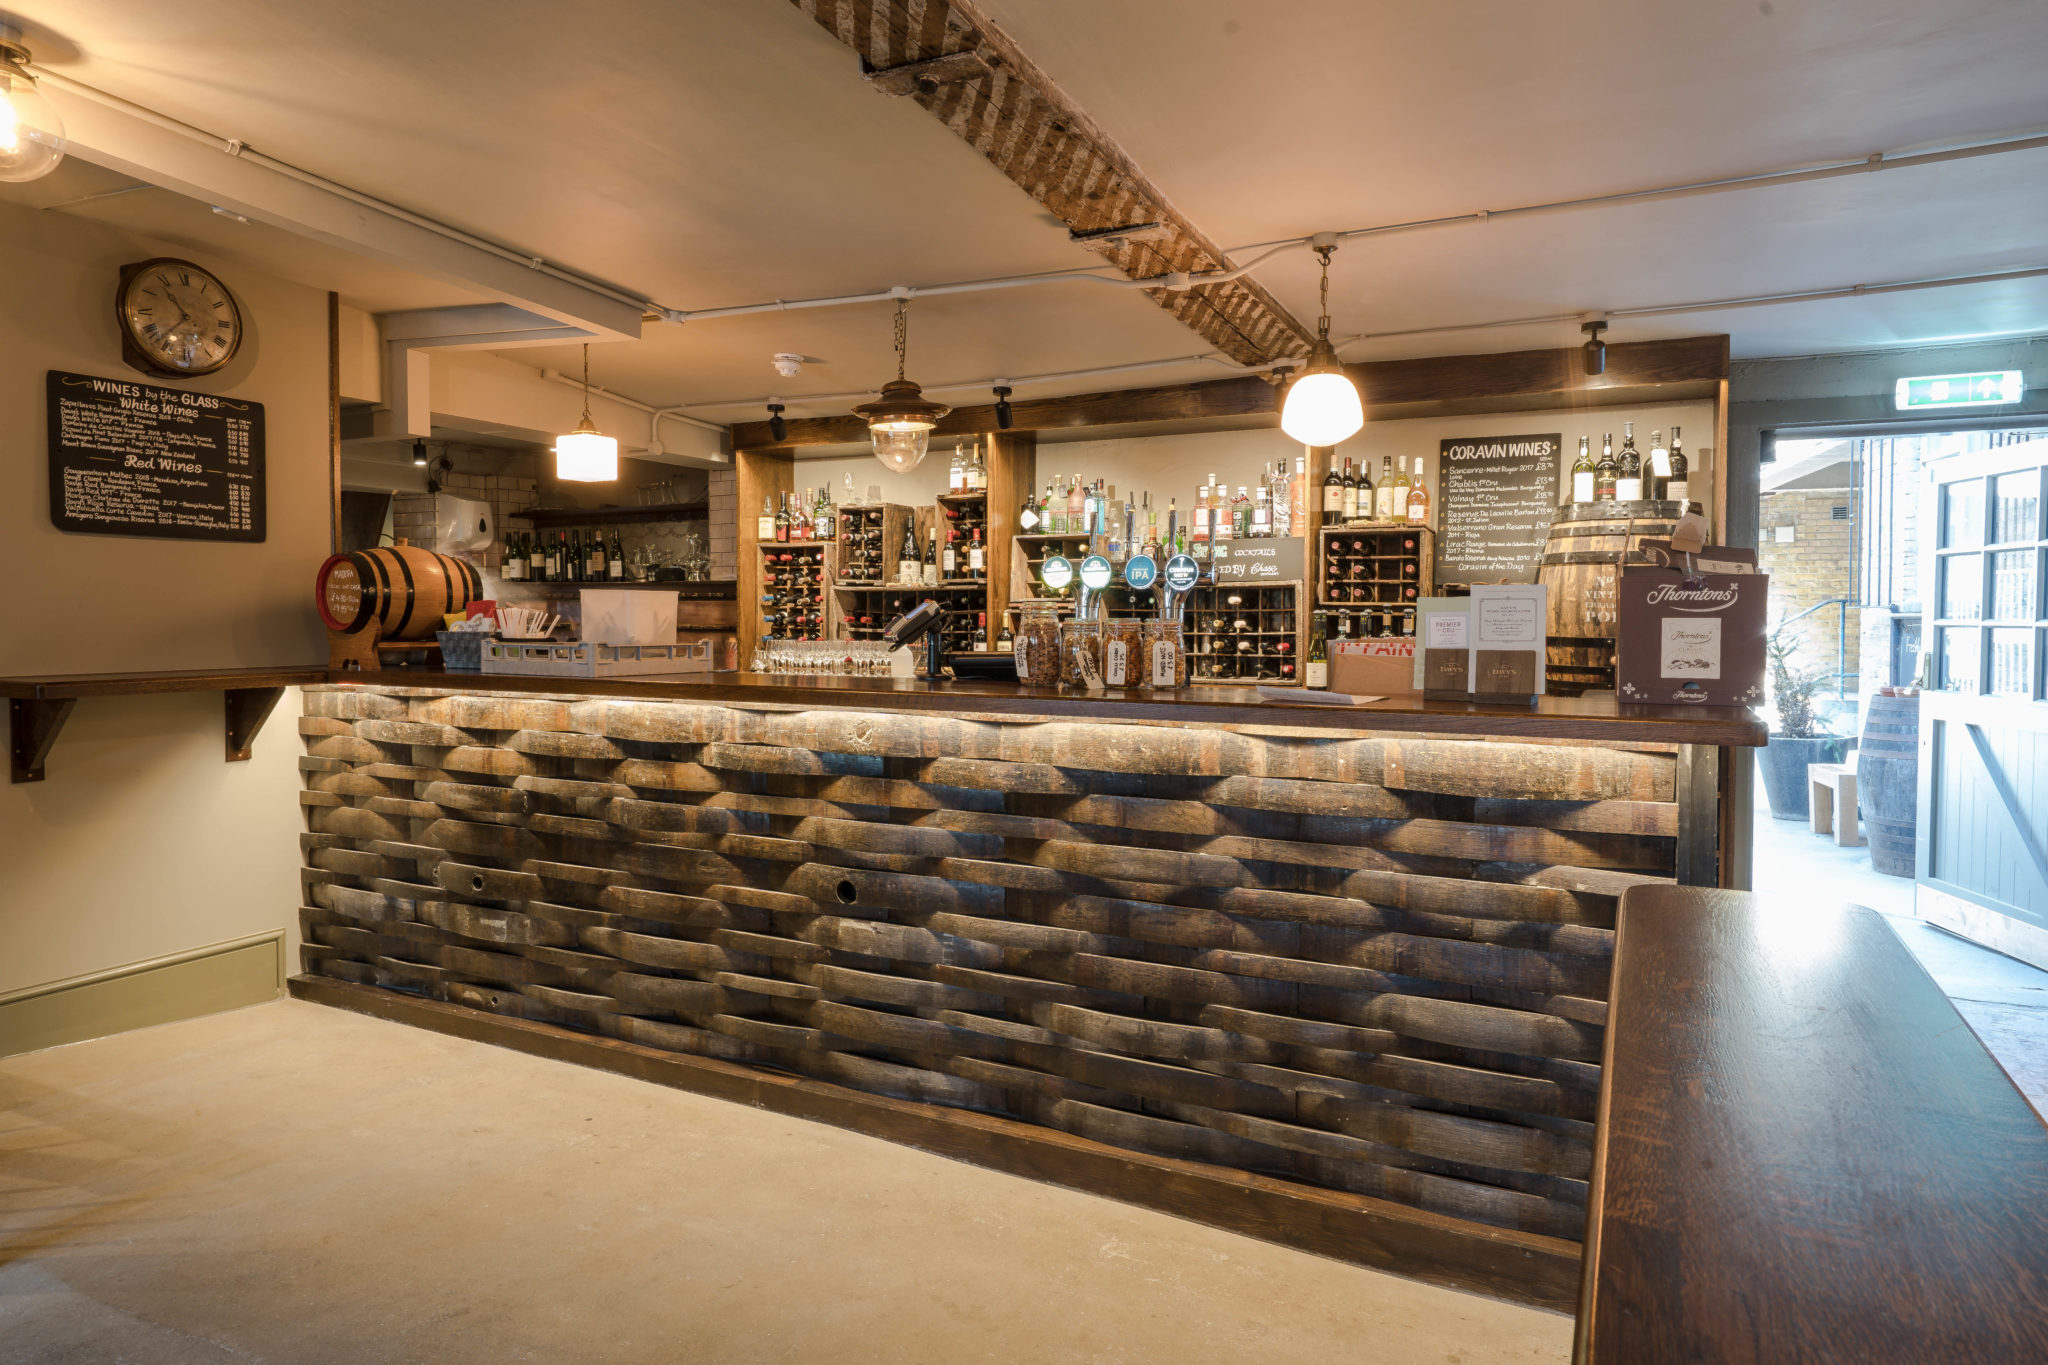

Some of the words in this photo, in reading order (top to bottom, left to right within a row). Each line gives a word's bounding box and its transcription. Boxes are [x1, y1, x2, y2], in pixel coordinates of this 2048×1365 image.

[93, 380, 140, 398] WINES
[146, 388, 158, 400] by
[160, 390, 178, 402] the
[181, 393, 220, 409] GLASS
[119, 397, 159, 413] White
[162, 403, 200, 418] Wines
[1450, 444, 1506, 460] CORAVIN
[1508, 441, 1551, 457] WINES
[124, 454, 156, 470] Red
[157, 457, 202, 474] Wines
[1519, 464, 1534, 472] 2017
[1448, 480, 1478, 488] Chablis
[1232, 564, 1246, 577] BY
[1507, 562, 1524, 572] Day
[1131, 570, 1149, 580] IPA
[1647, 584, 1736, 607] Thorntons
[1671, 631, 1712, 643] Thorntons
